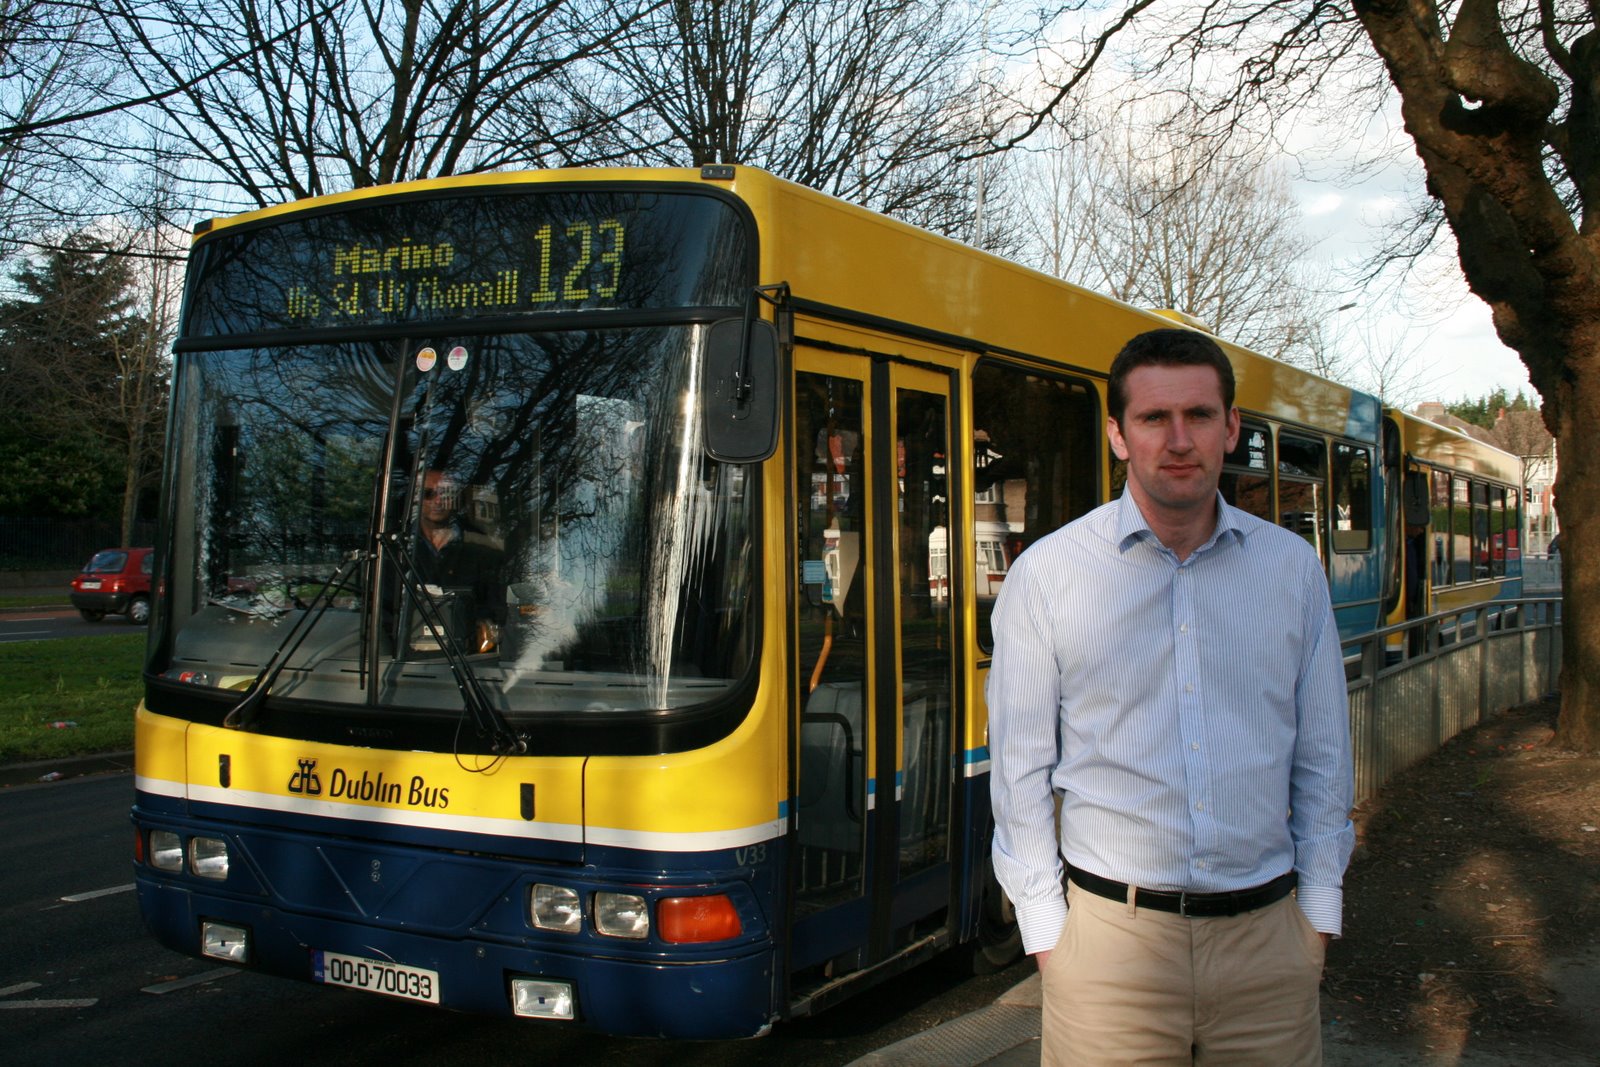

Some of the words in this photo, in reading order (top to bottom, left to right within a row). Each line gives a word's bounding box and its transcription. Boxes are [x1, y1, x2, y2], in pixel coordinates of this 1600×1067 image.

[334, 237, 454, 275] Marino
[531, 219, 625, 303] 123
[288, 286, 320, 319] Via
[331, 282, 365, 315] Sd.
[417, 270, 518, 310] Chonaill
[329, 768, 402, 804] Dublin
[407, 775, 450, 809] Bus
[735, 844, 766, 866] V33
[331, 958, 432, 999] 00-D-70033
